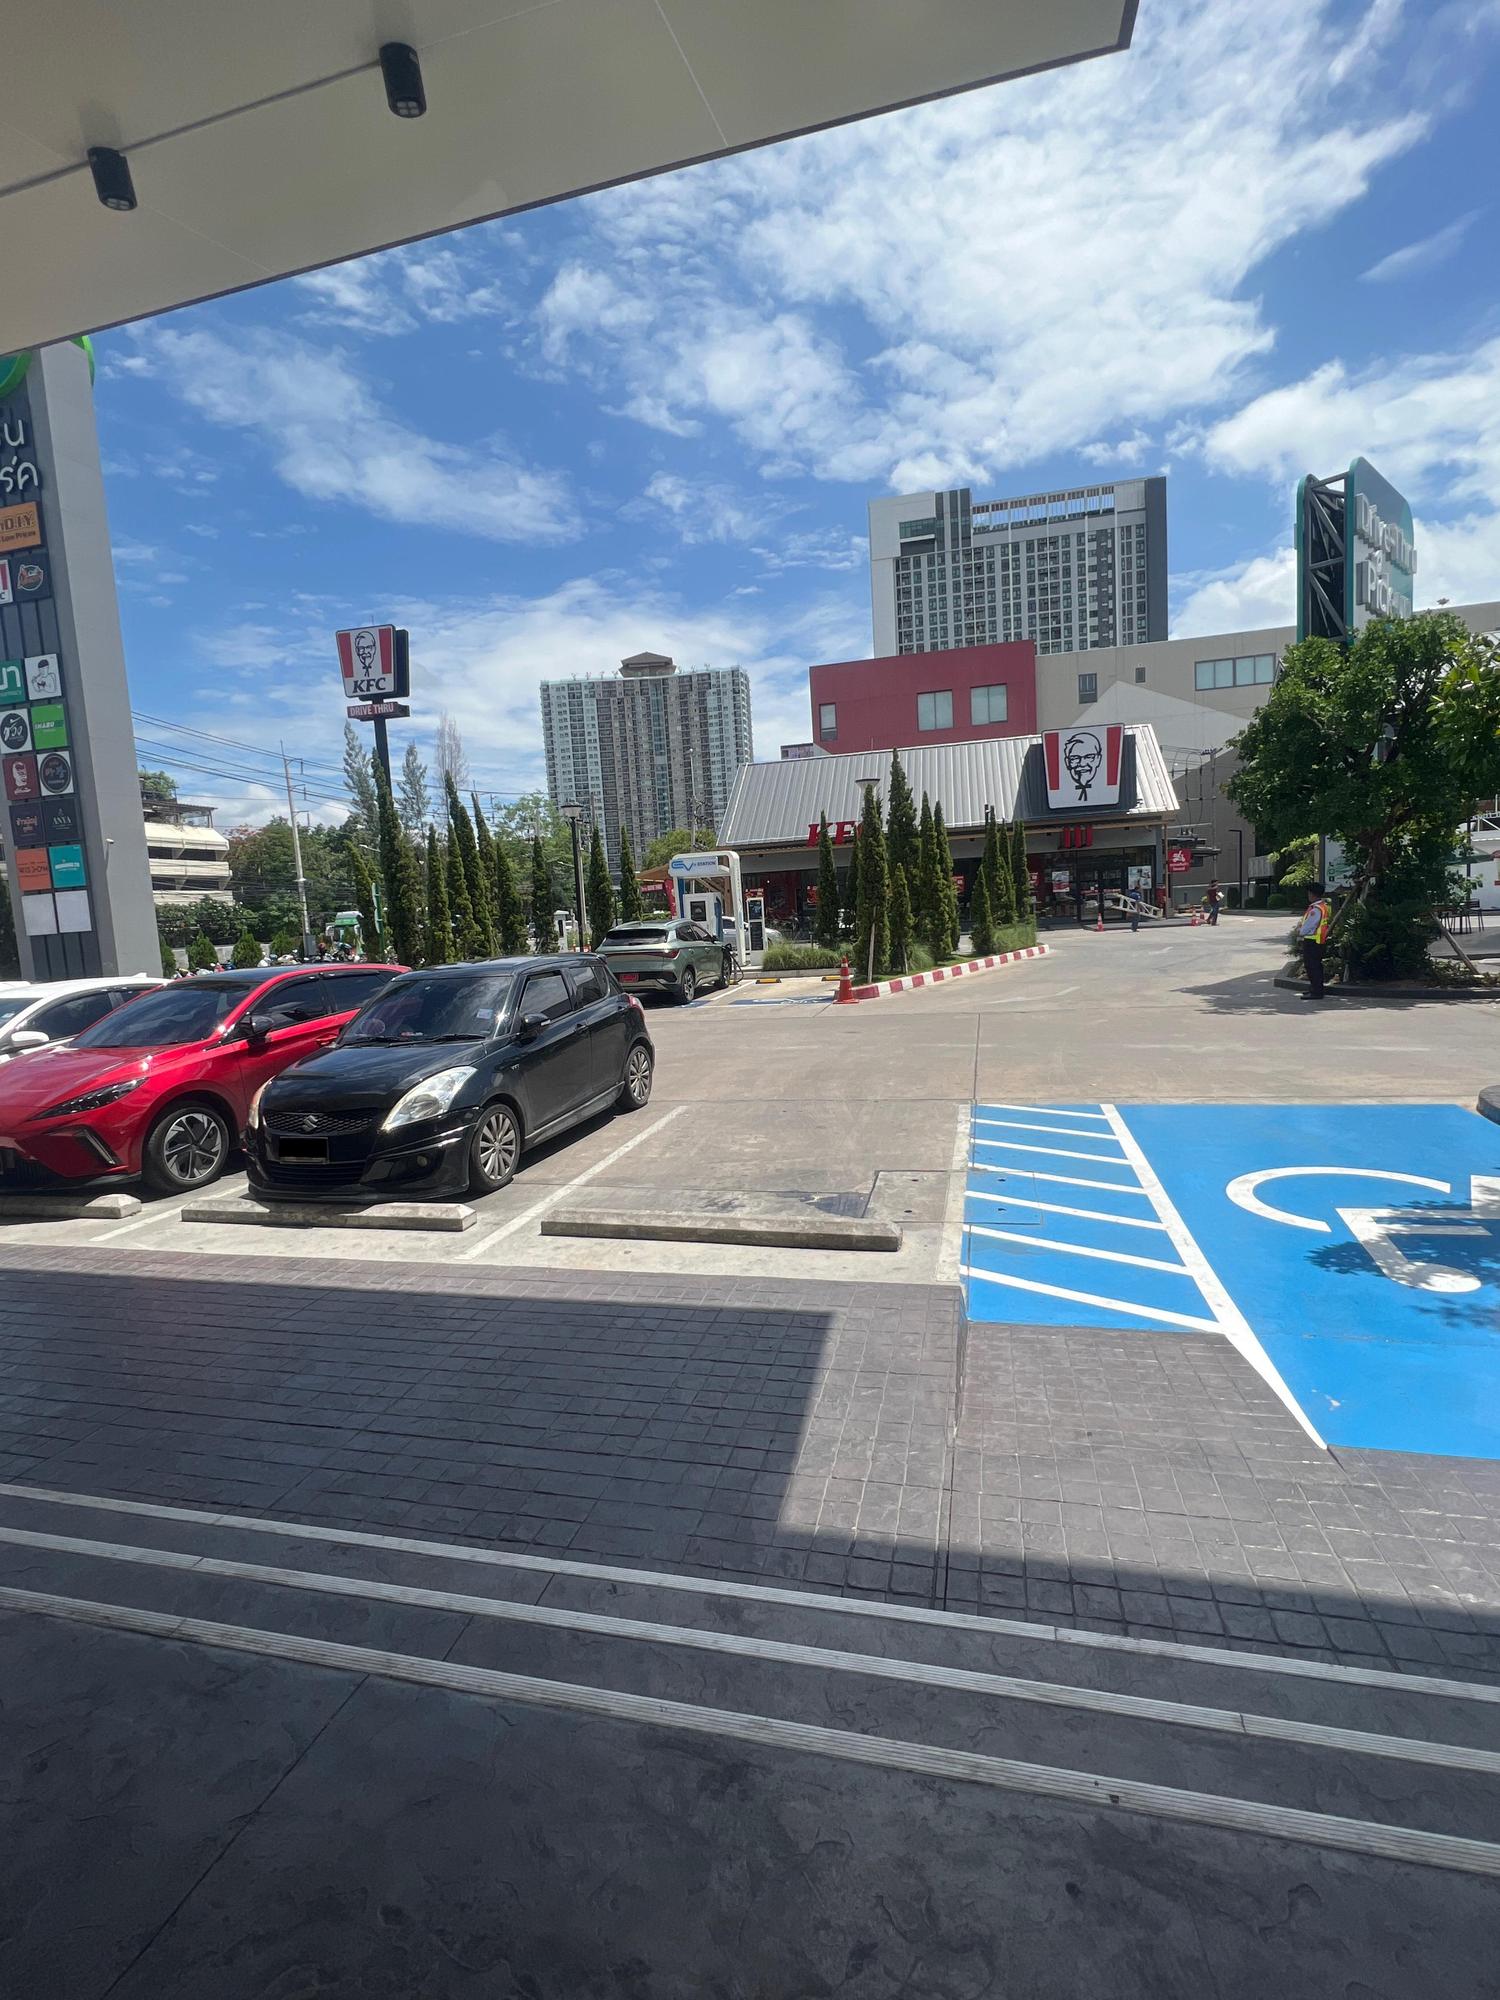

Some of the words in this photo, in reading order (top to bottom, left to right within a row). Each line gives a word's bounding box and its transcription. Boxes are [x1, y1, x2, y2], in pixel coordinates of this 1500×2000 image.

[352, 677, 386, 694] KFC
[350, 705, 373, 716] DRIVE
[374, 703, 394, 714] THRU
